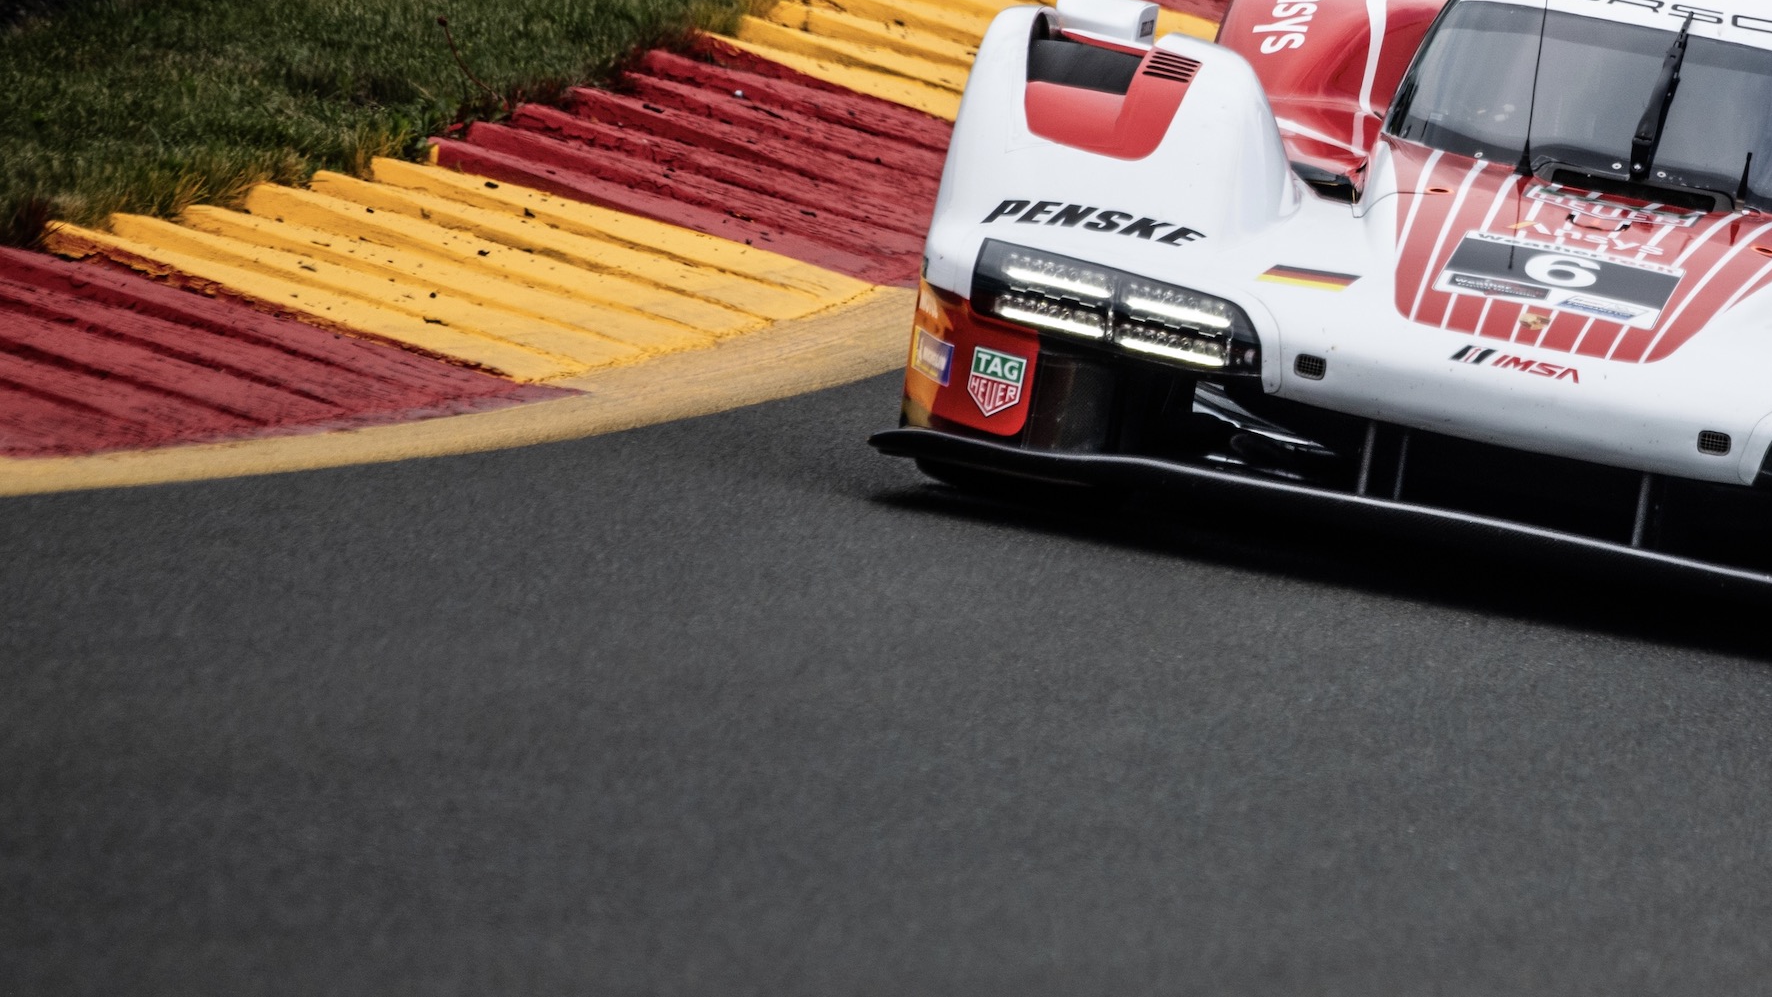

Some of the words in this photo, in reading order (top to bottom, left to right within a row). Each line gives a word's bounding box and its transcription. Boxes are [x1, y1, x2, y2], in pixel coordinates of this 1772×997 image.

[980, 199, 1206, 248] PENSKE
[1524, 253, 1601, 288] 6
[977, 352, 1019, 381] TAG
[1491, 354, 1580, 384] IMSA
[970, 377, 1017, 411] HEUER
